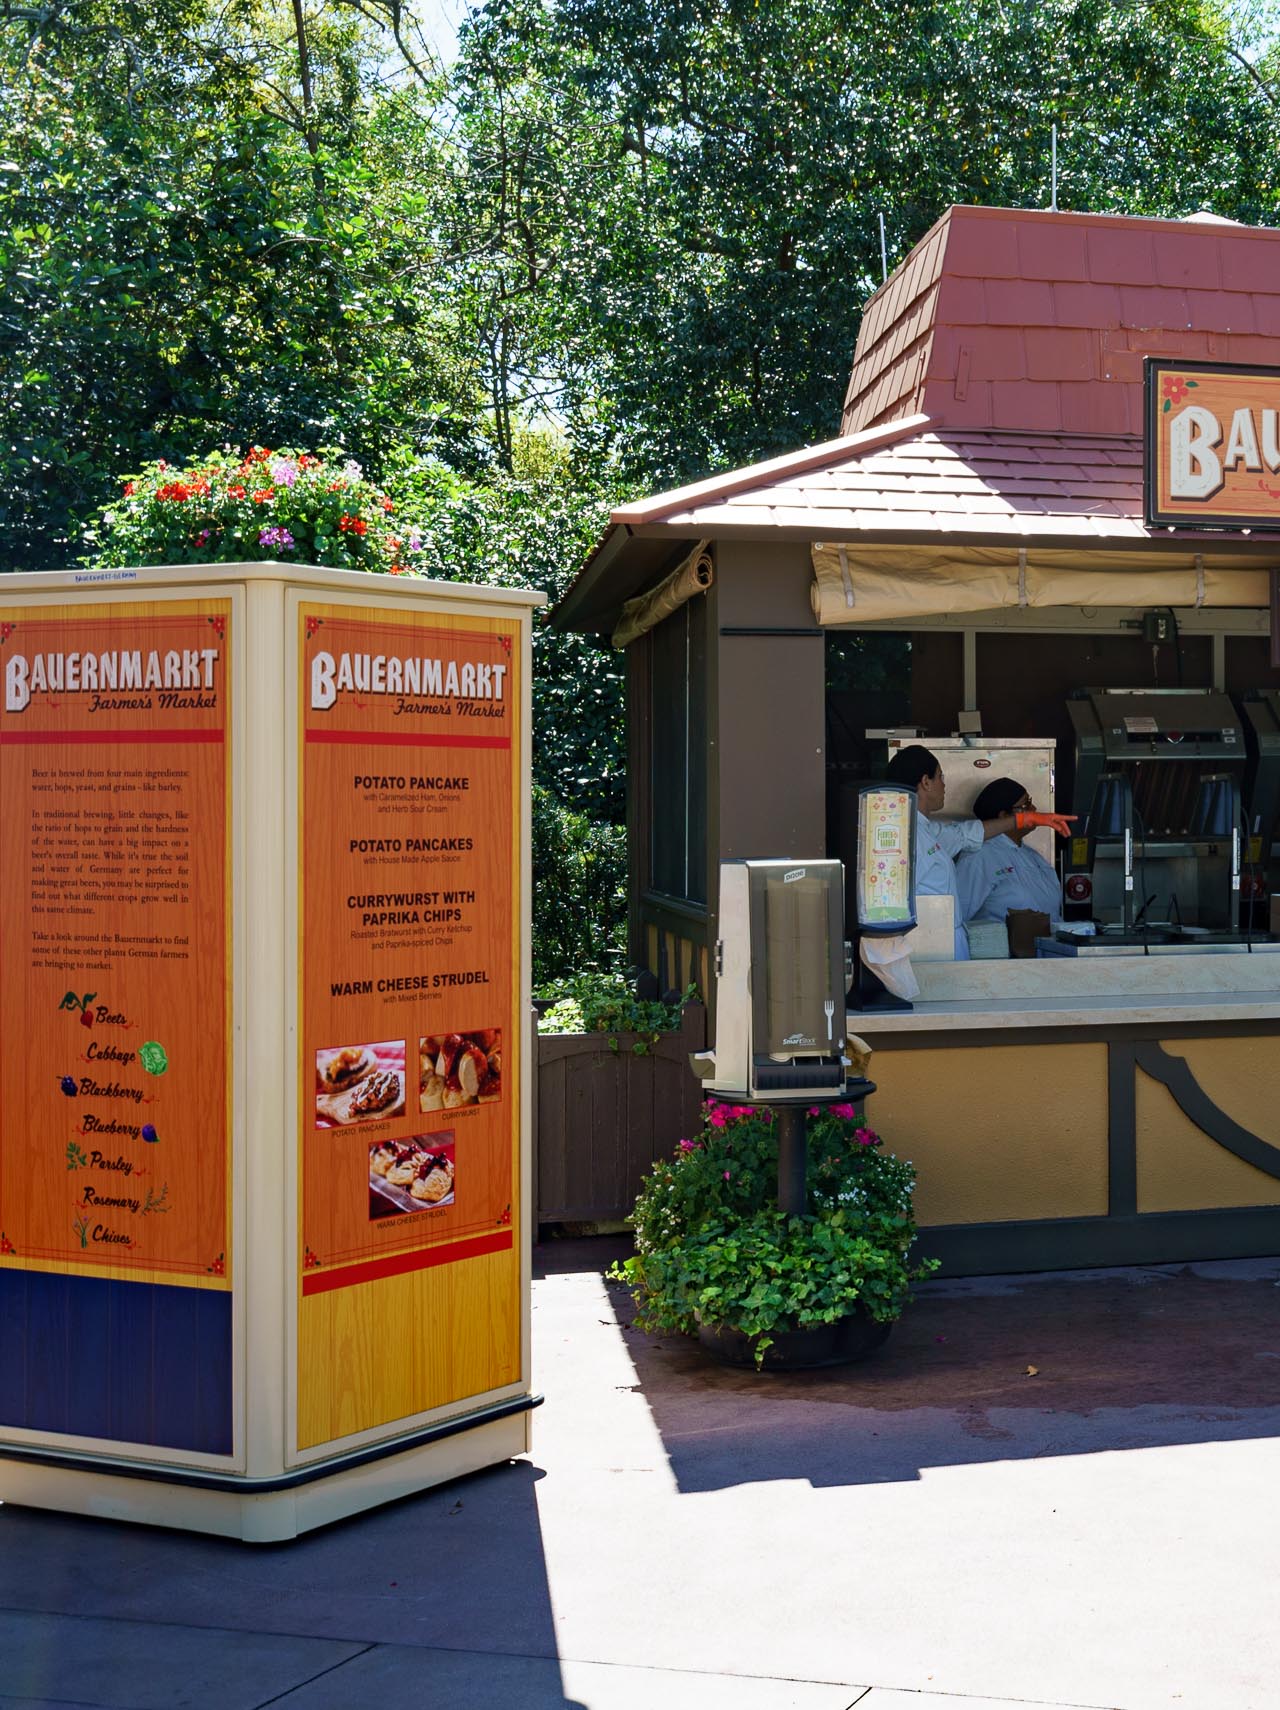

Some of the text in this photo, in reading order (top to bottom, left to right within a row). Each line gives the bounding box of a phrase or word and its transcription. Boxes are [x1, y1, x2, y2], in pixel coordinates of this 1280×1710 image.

[6, 648, 219, 713] BAUERNMARKT
[312, 651, 506, 711] BAUERNMARKT
[89, 693, 217, 712] Farmer's Market
[394, 698, 505, 718] Farmer's Market
[32, 769, 189, 779] Beer is brewed from four main ingredients:
[32, 783, 182, 793] water, hops, yeast, and grains like barley.
[354, 776, 469, 790] POTATO PANCAKE
[379, 793, 419, 801] Caramelized
[32, 810, 188, 820] In traditional brewing, little changes, like
[378, 805, 447, 813] and Herb Sour Cream
[32, 824, 43, 832] the
[45, 824, 61, 832] ratio
[64, 824, 71, 832] of
[74, 824, 91, 834] hops
[104, 825, 122, 834] grain
[126, 824, 139, 832] and
[142, 824, 153, 833] the
[156, 824, 188, 833] hardness
[32, 837, 39, 845] of
[43, 837, 54, 845] the
[58, 838, 79, 846] water,
[99, 838, 114, 846] have
[126, 838, 138, 848] big
[142, 838, 168, 849] impact
[350, 838, 473, 852] POTATO PANCAKES
[32, 851, 52, 859] beer's
[56, 851, 78, 859] overall
[104, 851, 124, 859] While
[128, 851, 139, 859] it's
[160, 852, 172, 860] the
[176, 852, 188, 860] soil
[363, 856, 377, 864] with
[379, 856, 400, 864] House
[421, 855, 440, 863] Apple
[32, 864, 44, 873] and
[51, 865, 69, 873] water
[75, 865, 82, 873] of
[90, 865, 122, 875] Germany
[147, 865, 172, 877] perfect
[178, 866, 188, 874] for
[32, 879, 59, 888] making
[60, 880, 78, 888] great
[80, 879, 100, 888] beers,
[102, 881, 116, 889] you
[117, 881, 132, 889] may
[134, 879, 143, 888] be
[145, 880, 179, 890] surprised
[32, 891, 45, 899] find
[64, 892, 81, 900] what
[84, 892, 115, 901] different
[118, 895, 137, 904] crops
[141, 896, 160, 904] grow
[163, 894, 177, 902] well
[181, 894, 188, 902] in
[347, 891, 475, 908] CURRYWURST WITH
[66, 906, 95, 914] climate.
[363, 909, 461, 926] PAPRIKA CHIPS
[32, 932, 49, 940] Take
[56, 933, 70, 941] look
[74, 933, 99, 942] around
[101, 933, 112, 942] the
[115, 934, 162, 944] Bauernmarkt
[174, 936, 188, 945] find
[351, 925, 472, 939] Roasted Bratwurst with Curry Ketchup
[372, 937, 453, 950] and Paprika-spiced Chips
[63, 946, 80, 955] these
[83, 947, 102, 955] other
[104, 948, 126, 958] plants
[128, 948, 158, 958] German
[160, 949, 188, 959] farmers
[331, 971, 489, 997] WARM CHEESE STRUDEL
[95, 1006, 127, 1025] Beets
[87, 1042, 136, 1066] Cabbage
[80, 1077, 144, 1104] Blackberry
[83, 1114, 140, 1140] Blueberry
[332, 1123, 391, 1139] POTATO PANCAKES
[91, 1151, 133, 1176] Parsley
[83, 1186, 140, 1213] Rosemary
[92, 1224, 130, 1244] Chives
